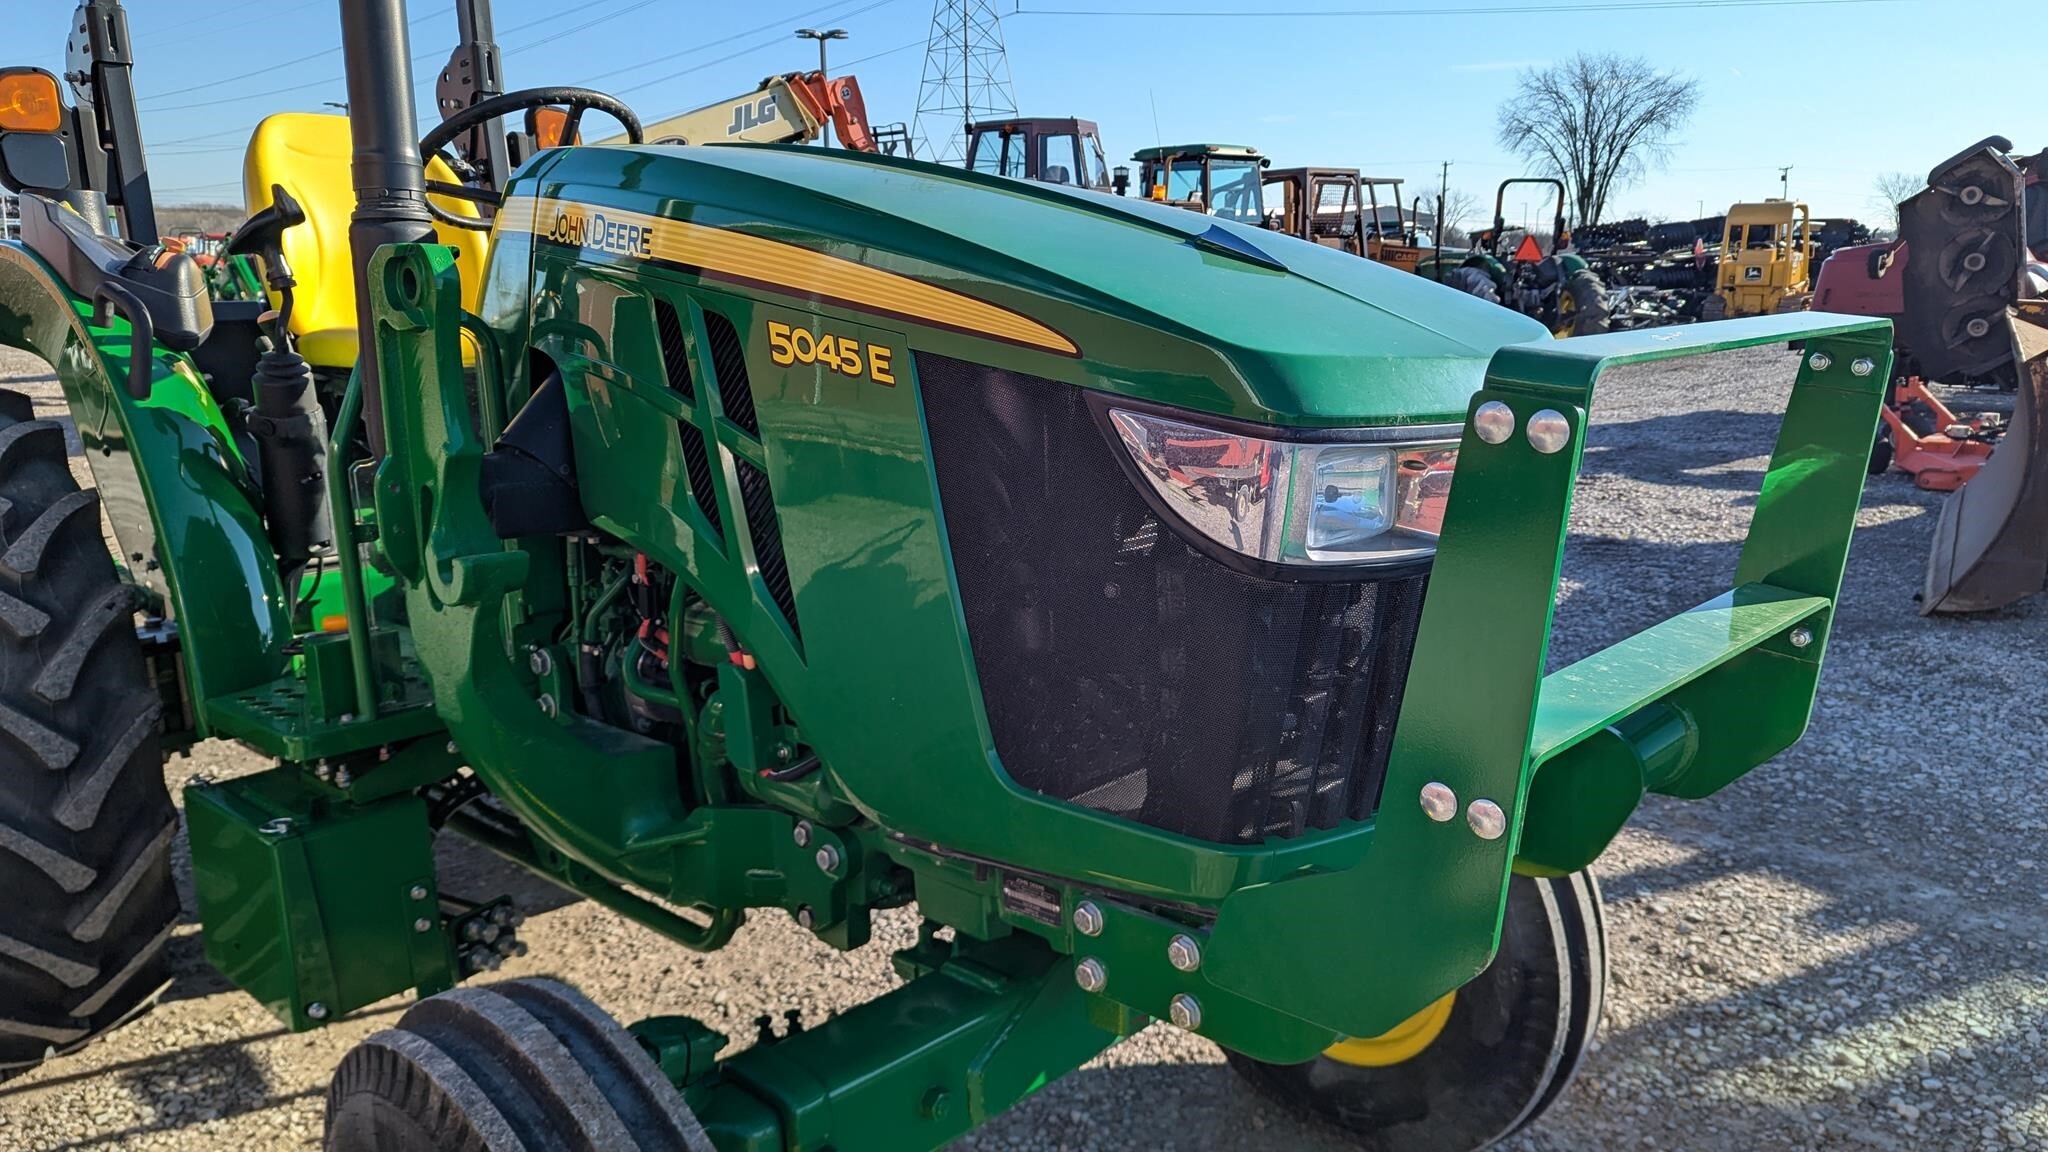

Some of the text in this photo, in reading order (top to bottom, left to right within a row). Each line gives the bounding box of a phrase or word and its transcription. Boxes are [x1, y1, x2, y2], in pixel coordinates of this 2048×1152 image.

[728, 94, 777, 136] JLG
[549, 207, 653, 257] JOHN DEERE
[767, 320, 896, 386] 5045 E
